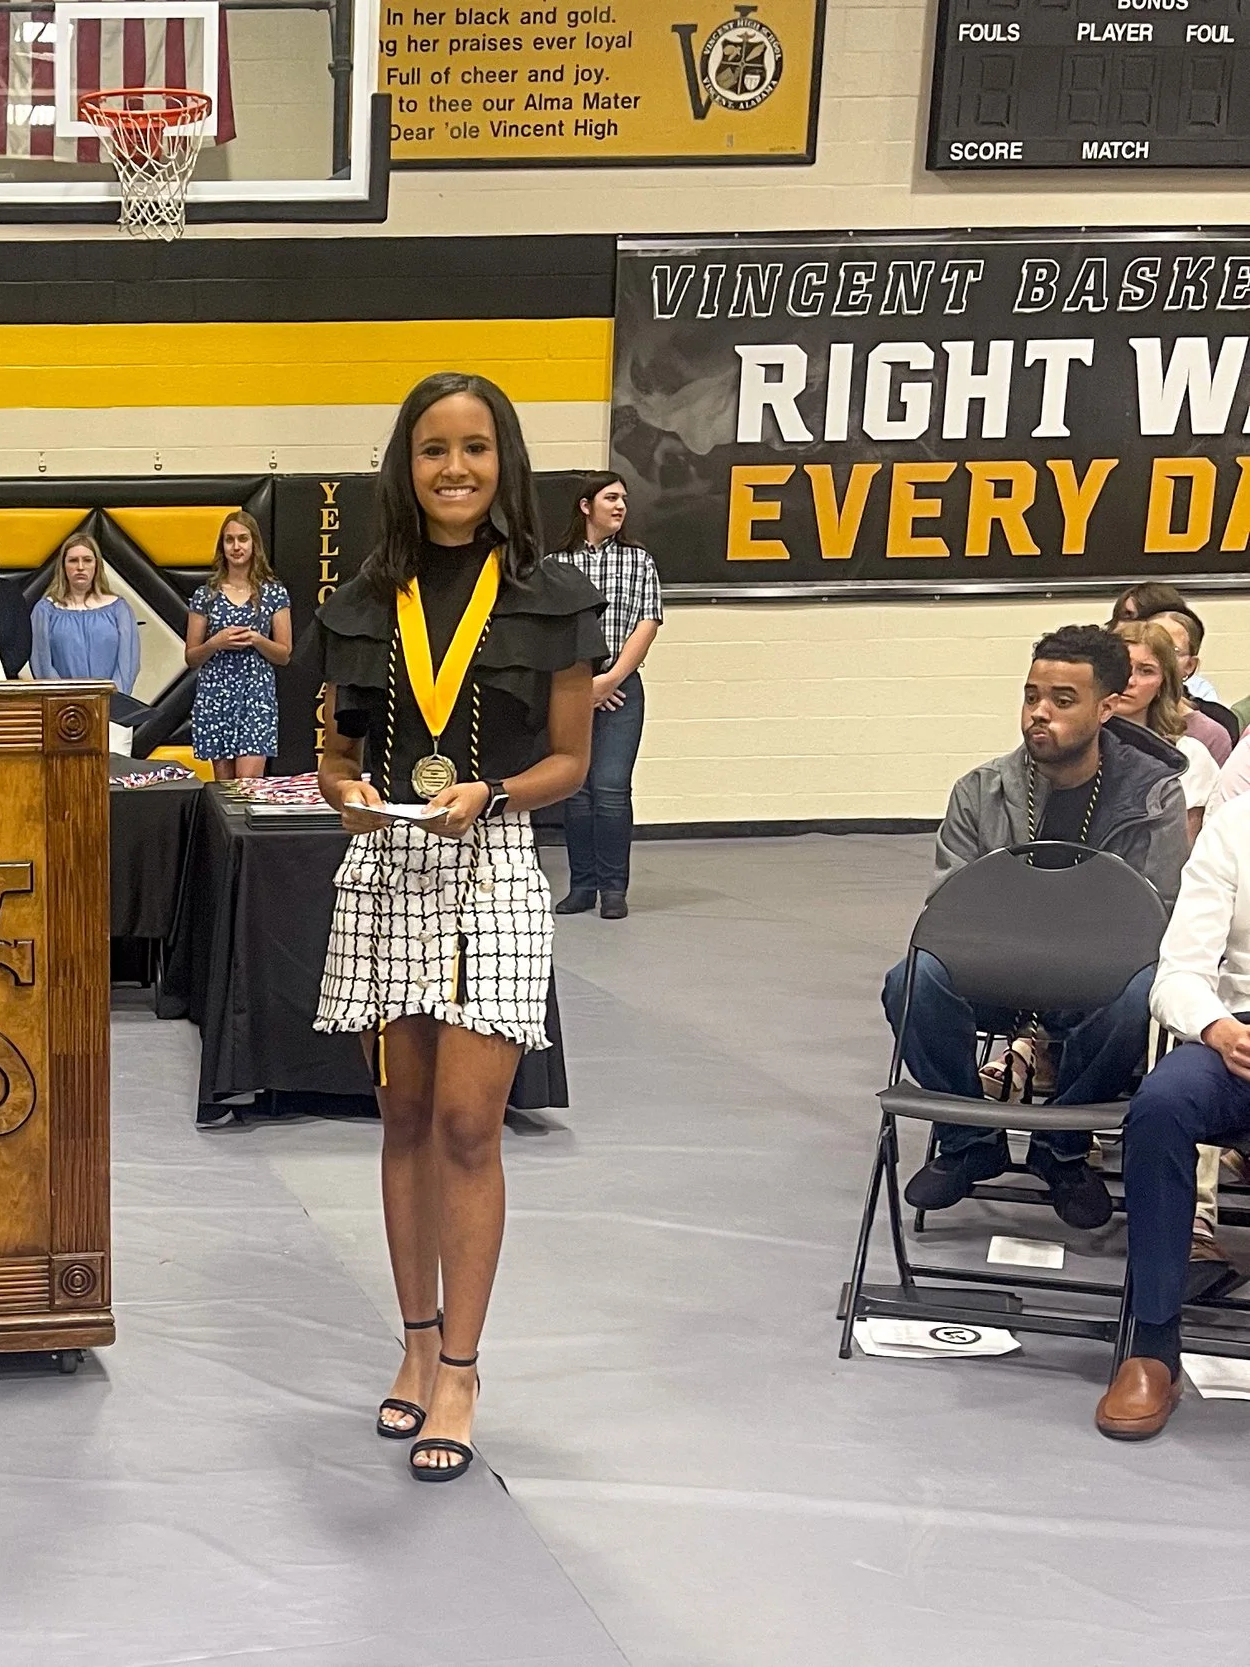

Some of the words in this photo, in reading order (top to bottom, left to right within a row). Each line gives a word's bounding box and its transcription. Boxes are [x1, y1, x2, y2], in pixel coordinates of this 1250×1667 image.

[1117, 0, 1189, 10] BONUS
[387, 8, 403, 26] In
[414, 8, 446, 25] her
[455, 8, 510, 25] black
[519, 7, 557, 24] and
[567, 6, 616, 28] gold.
[408, 35, 439, 52] her
[449, 34, 523, 55] praises
[533, 36, 576, 50] ever
[586, 31, 632, 52] loyal
[958, 24, 1020, 42] FOULS
[1077, 23, 1153, 42] PLAYER
[1186, 25, 1235, 43] FOUL
[387, 67, 420, 85] Full
[430, 67, 451, 84] of
[461, 66, 518, 83] cheer
[528, 65, 565, 82] and
[574, 64, 610, 85] joy.
[399, 97, 418, 112] to
[429, 95, 472, 112] thee
[482, 97, 515, 111] our
[524, 94, 573, 111] Alma
[583, 92, 641, 110] Mater
[391, 124, 435, 141] Dear
[490, 120, 565, 138] Vincent
[574, 119, 618, 140] High
[950, 142, 1023, 160] SCORE
[1082, 142, 1149, 159] MATCH
[652, 258, 984, 319] VINCENT
[734, 338, 1095, 443] RIGHT
[1128, 335, 1250, 436] W
[726, 458, 1119, 560] EVERY
